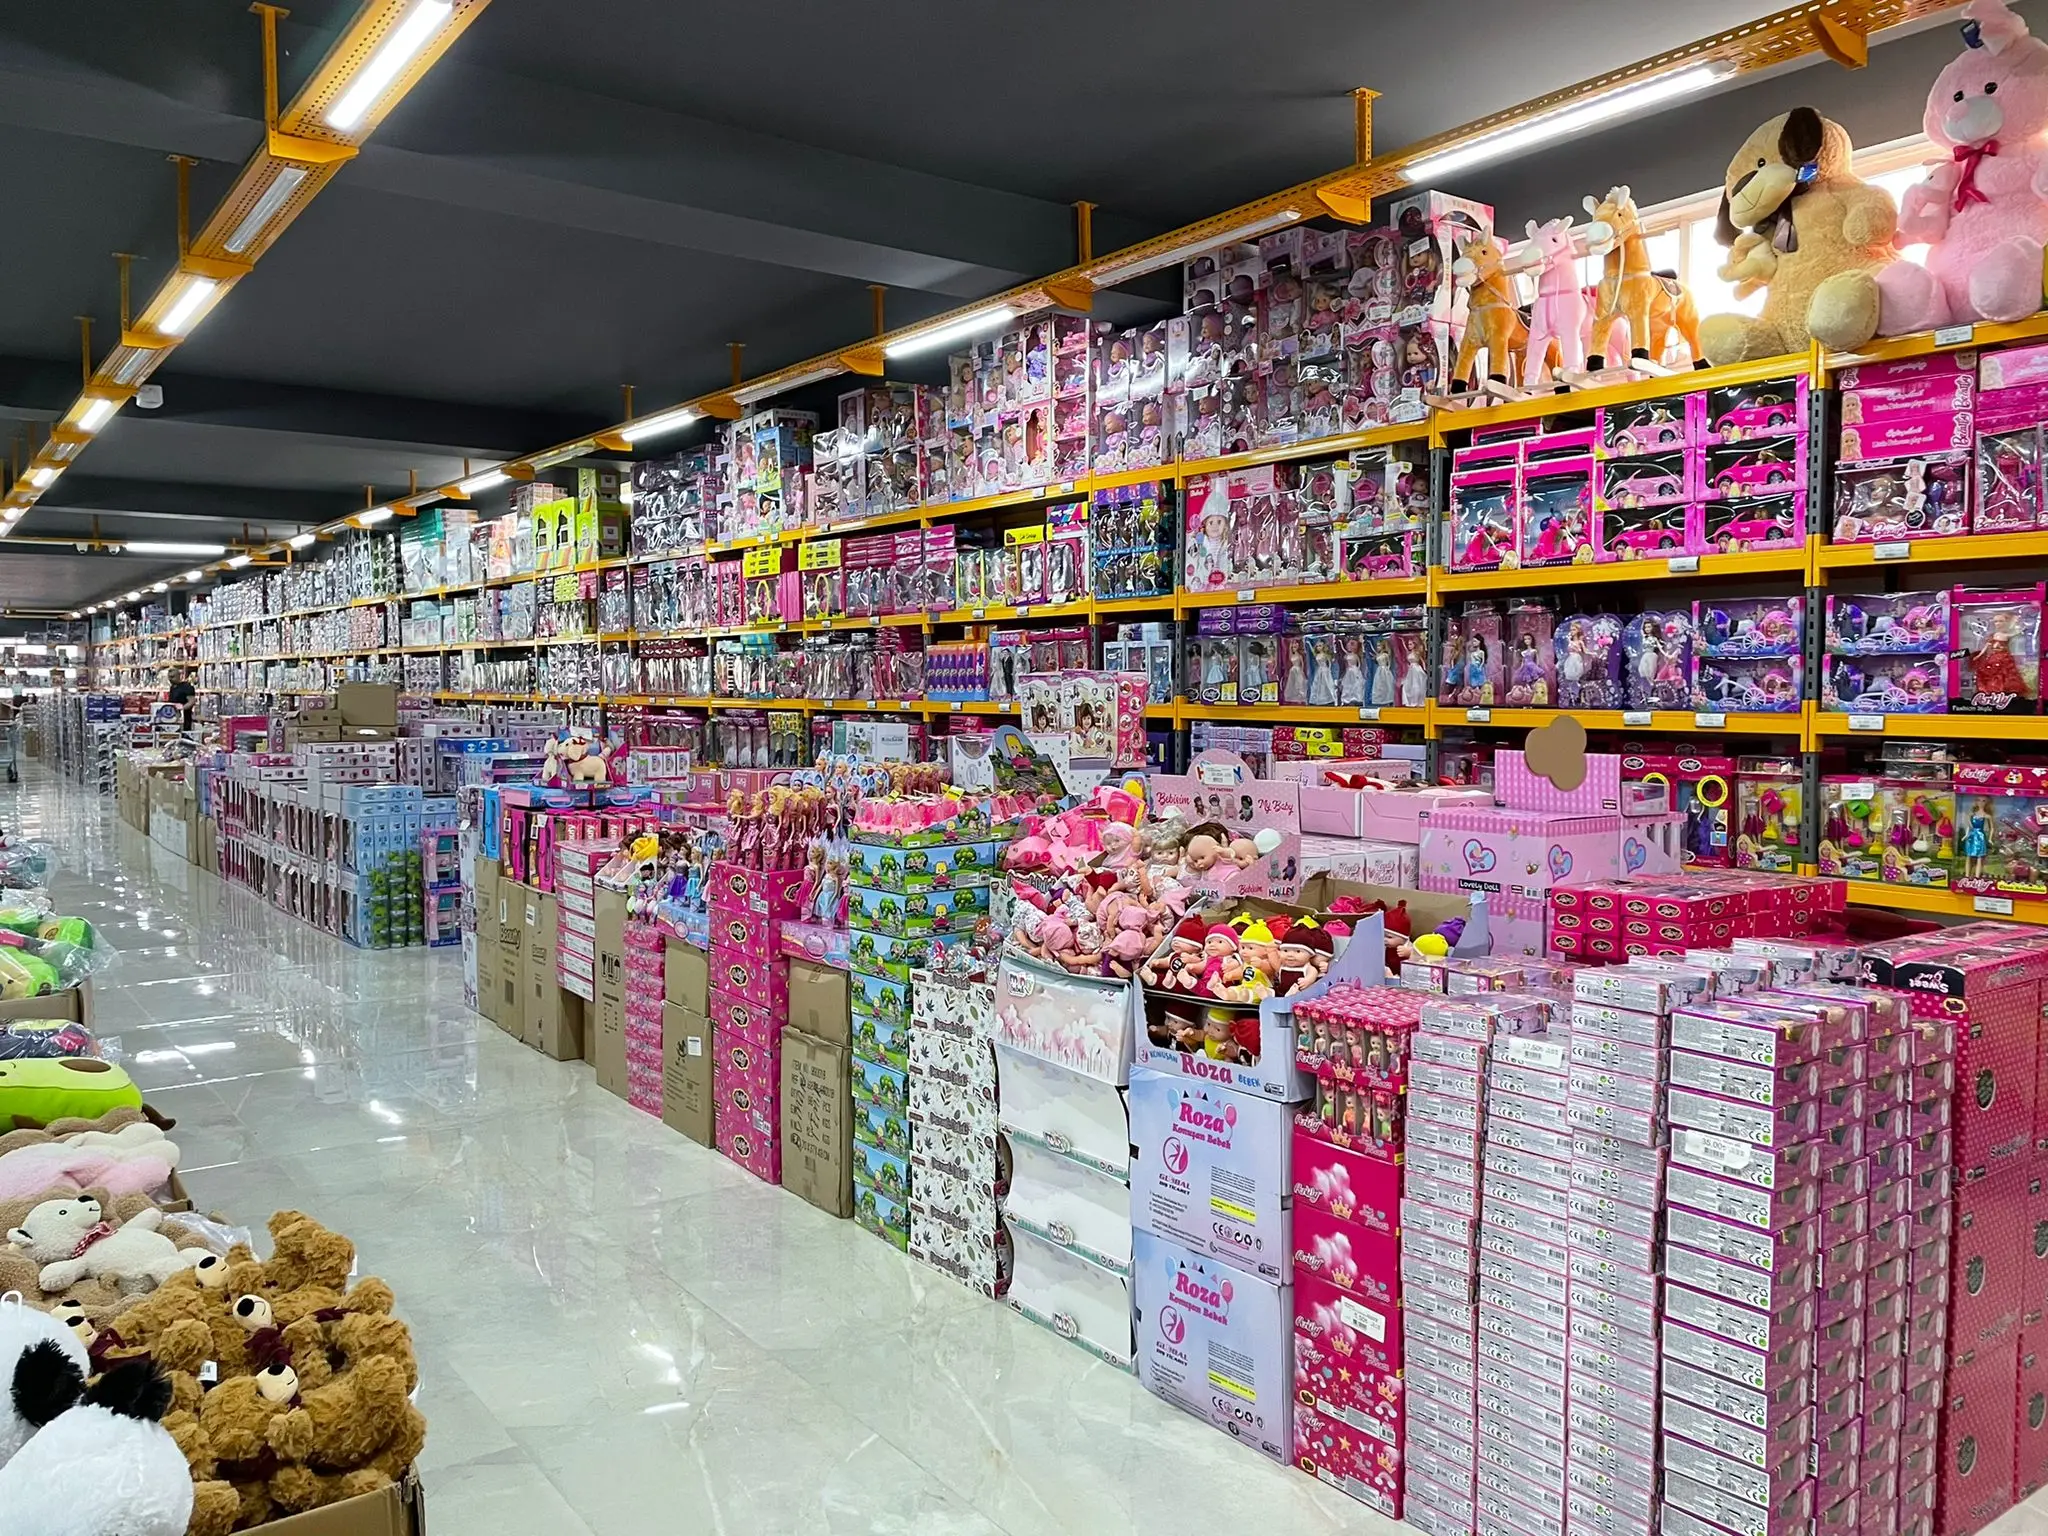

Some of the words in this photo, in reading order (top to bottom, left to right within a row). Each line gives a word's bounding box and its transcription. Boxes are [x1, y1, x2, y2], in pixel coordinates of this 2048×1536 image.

[1272, 800, 1294, 815] Baby
[1909, 978, 1949, 993] Sweet
[1180, 1052, 1233, 1084] Roza
[1179, 1102, 1224, 1133] Roza
[1207, 1133, 1231, 1149] Bebek
[1176, 1271, 1220, 1308] Roza
[1203, 1308, 1228, 1325] Bebek
